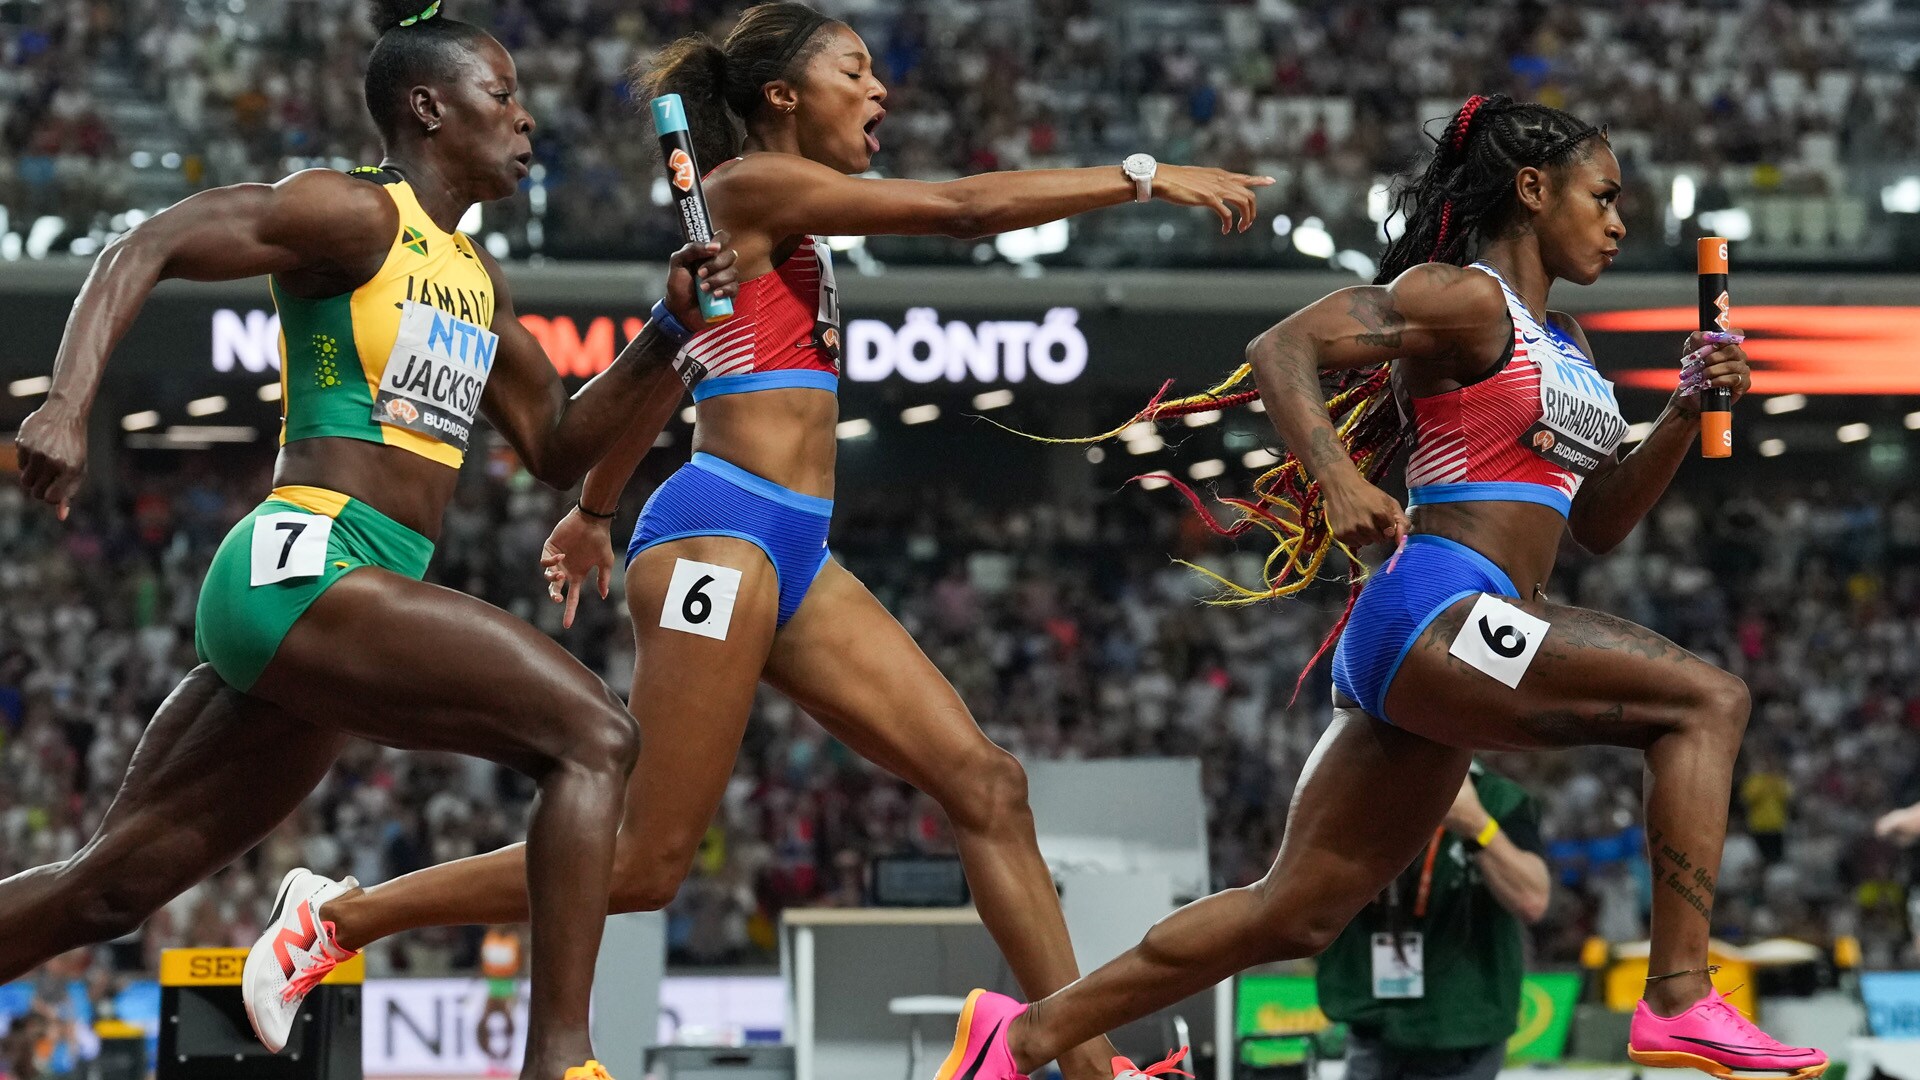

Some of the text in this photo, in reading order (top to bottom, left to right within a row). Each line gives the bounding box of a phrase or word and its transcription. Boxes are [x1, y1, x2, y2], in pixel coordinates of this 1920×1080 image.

[658, 101, 671, 119] 7
[428, 311, 496, 376] NTN
[391, 355, 483, 417] JACKSO
[1554, 359, 1615, 408] NTN
[423, 411, 469, 443] BUDAPES
[1545, 386, 1627, 451] RICHARDSON
[275, 522, 308, 570] 7
